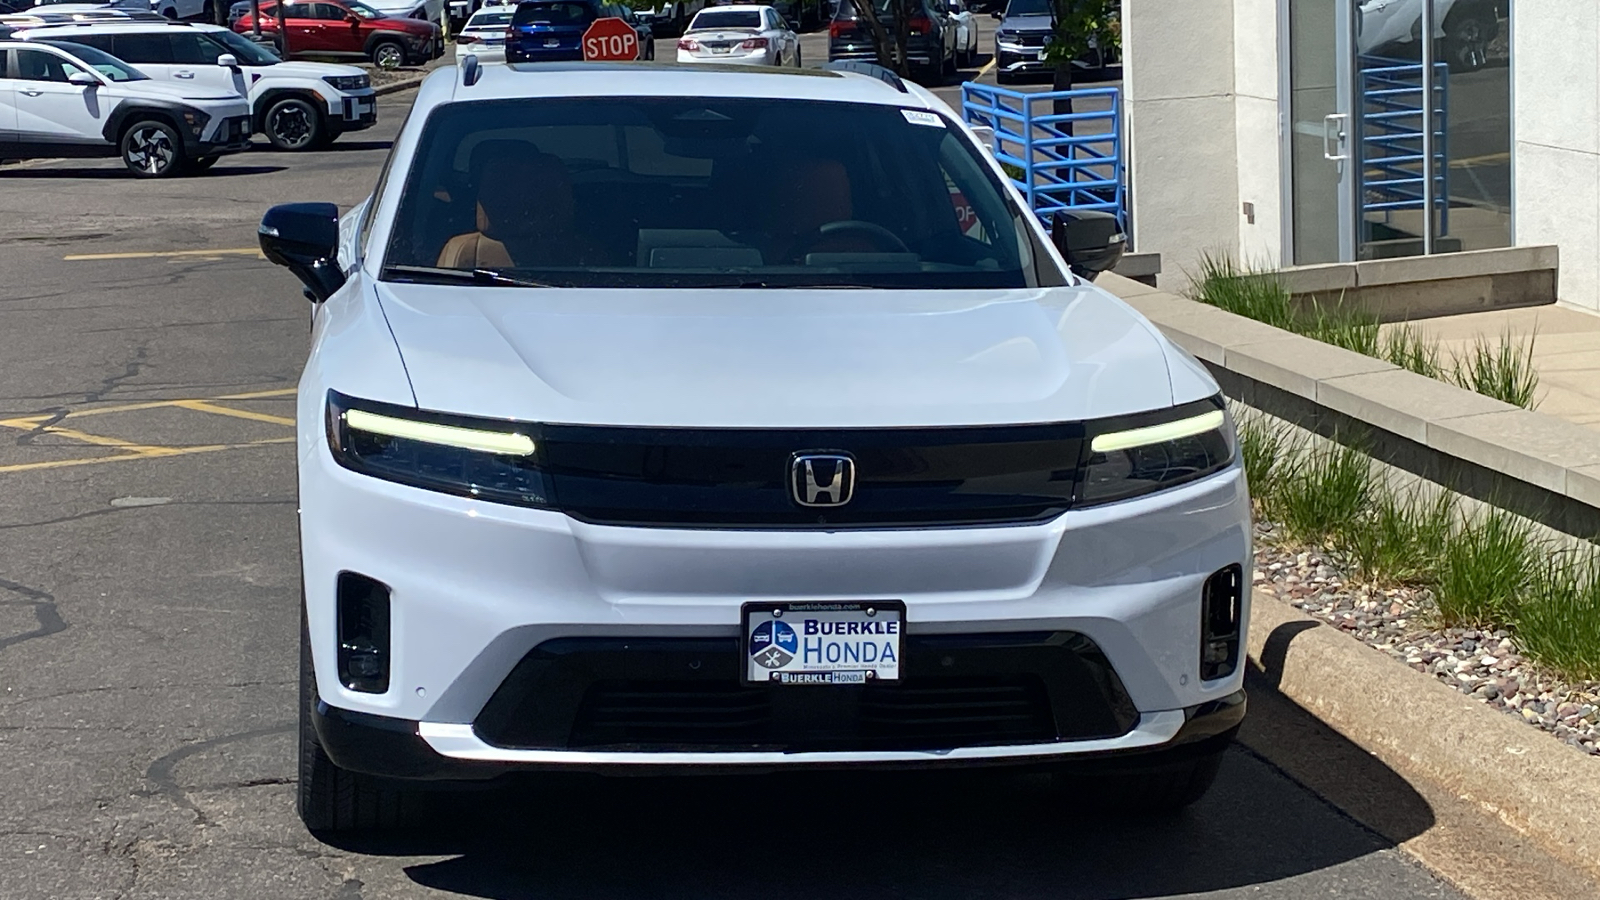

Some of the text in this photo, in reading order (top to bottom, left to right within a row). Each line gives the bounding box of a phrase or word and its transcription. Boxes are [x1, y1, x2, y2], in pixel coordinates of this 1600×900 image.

[586, 34, 634, 58] STOP
[955, 206, 975, 222] OP
[789, 603, 860, 611] buerklehonda.com
[804, 619, 898, 635] BUERKLE
[804, 637, 896, 664] HONDA
[781, 673, 864, 683] BUERKLE HONDA
